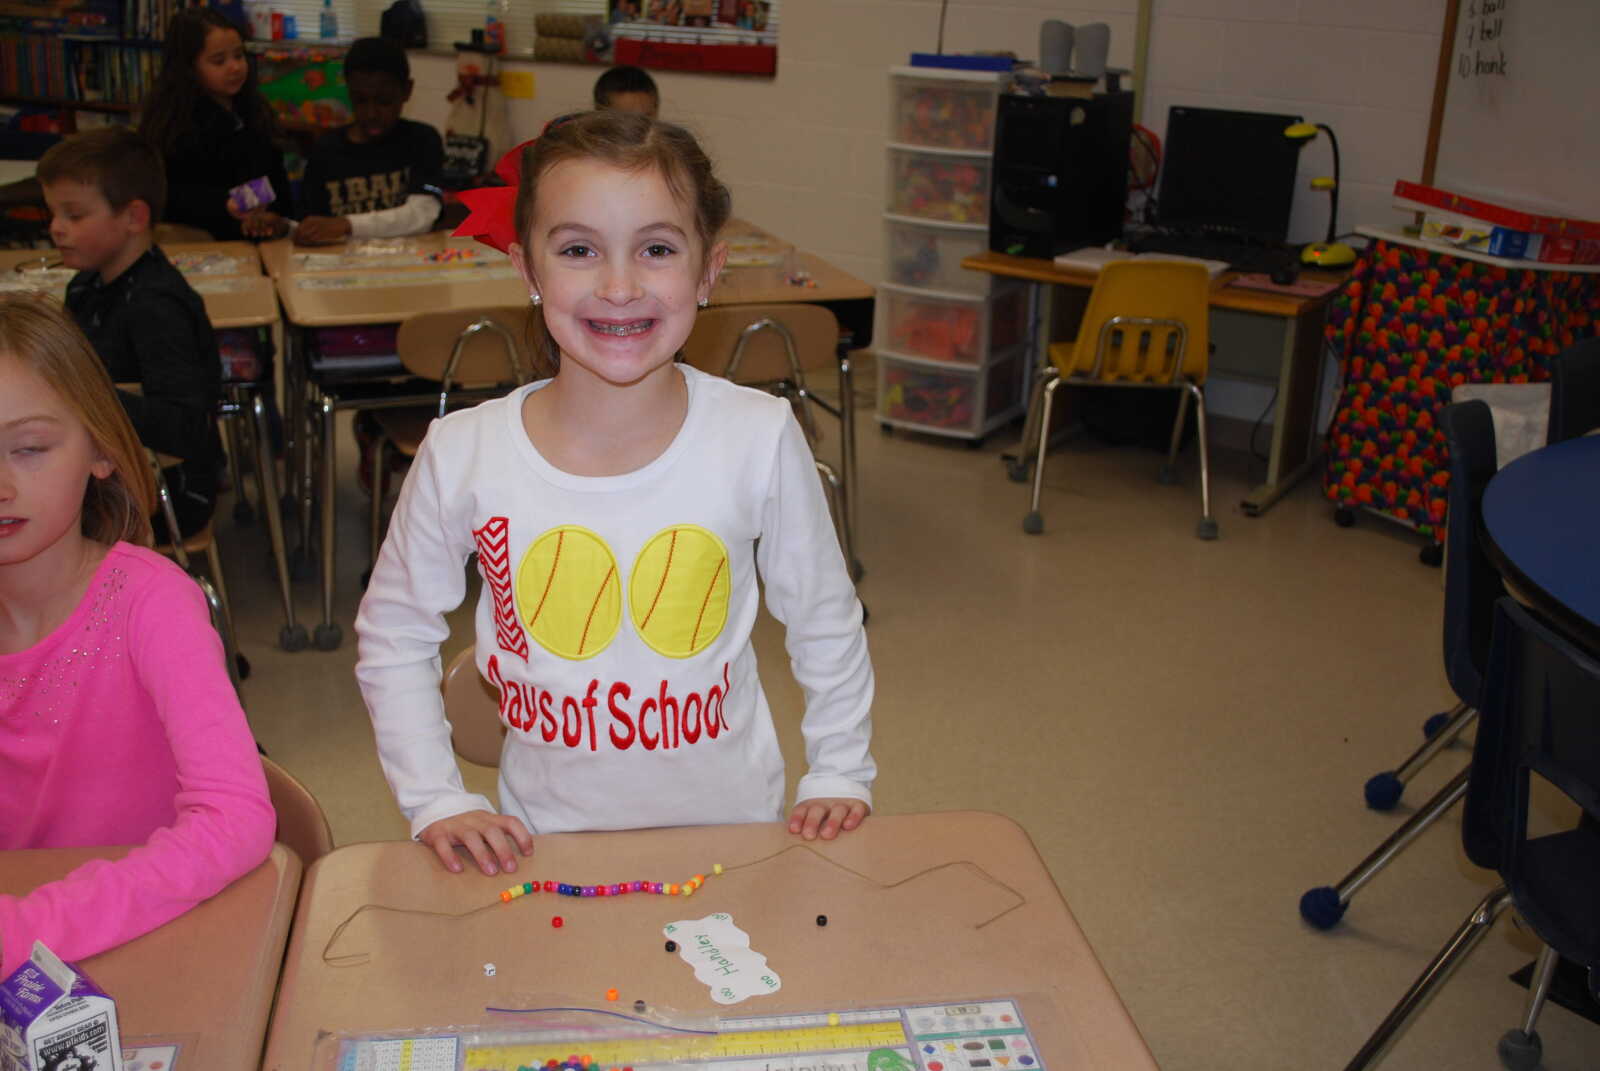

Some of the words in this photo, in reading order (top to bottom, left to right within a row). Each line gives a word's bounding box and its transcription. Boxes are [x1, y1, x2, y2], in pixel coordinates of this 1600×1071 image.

[472, 516, 731, 663] 100
[562, 679, 599, 751] of
[608, 662, 731, 751] School
